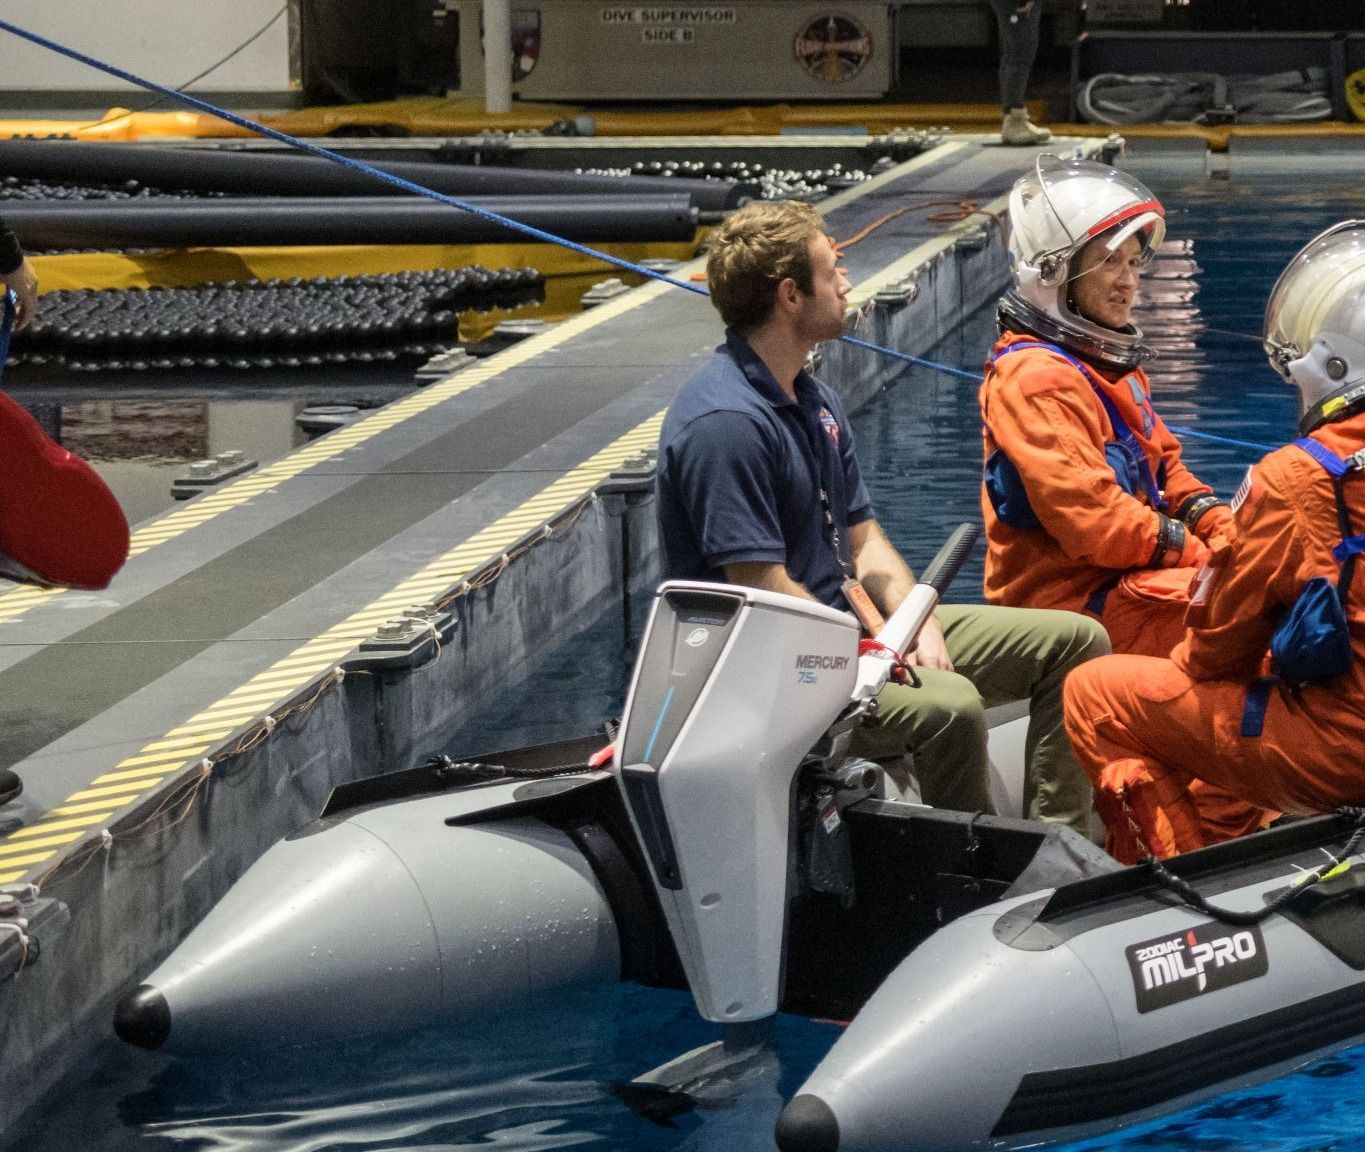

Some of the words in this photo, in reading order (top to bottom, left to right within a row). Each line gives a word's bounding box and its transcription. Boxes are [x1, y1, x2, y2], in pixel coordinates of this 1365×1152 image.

[602, 9, 634, 23] DIVE
[641, 9, 735, 23] SUPERVISOR
[644, 28, 674, 42] SIDE
[795, 654, 850, 671] MERCURY
[1136, 937, 1185, 962] ZODIAC
